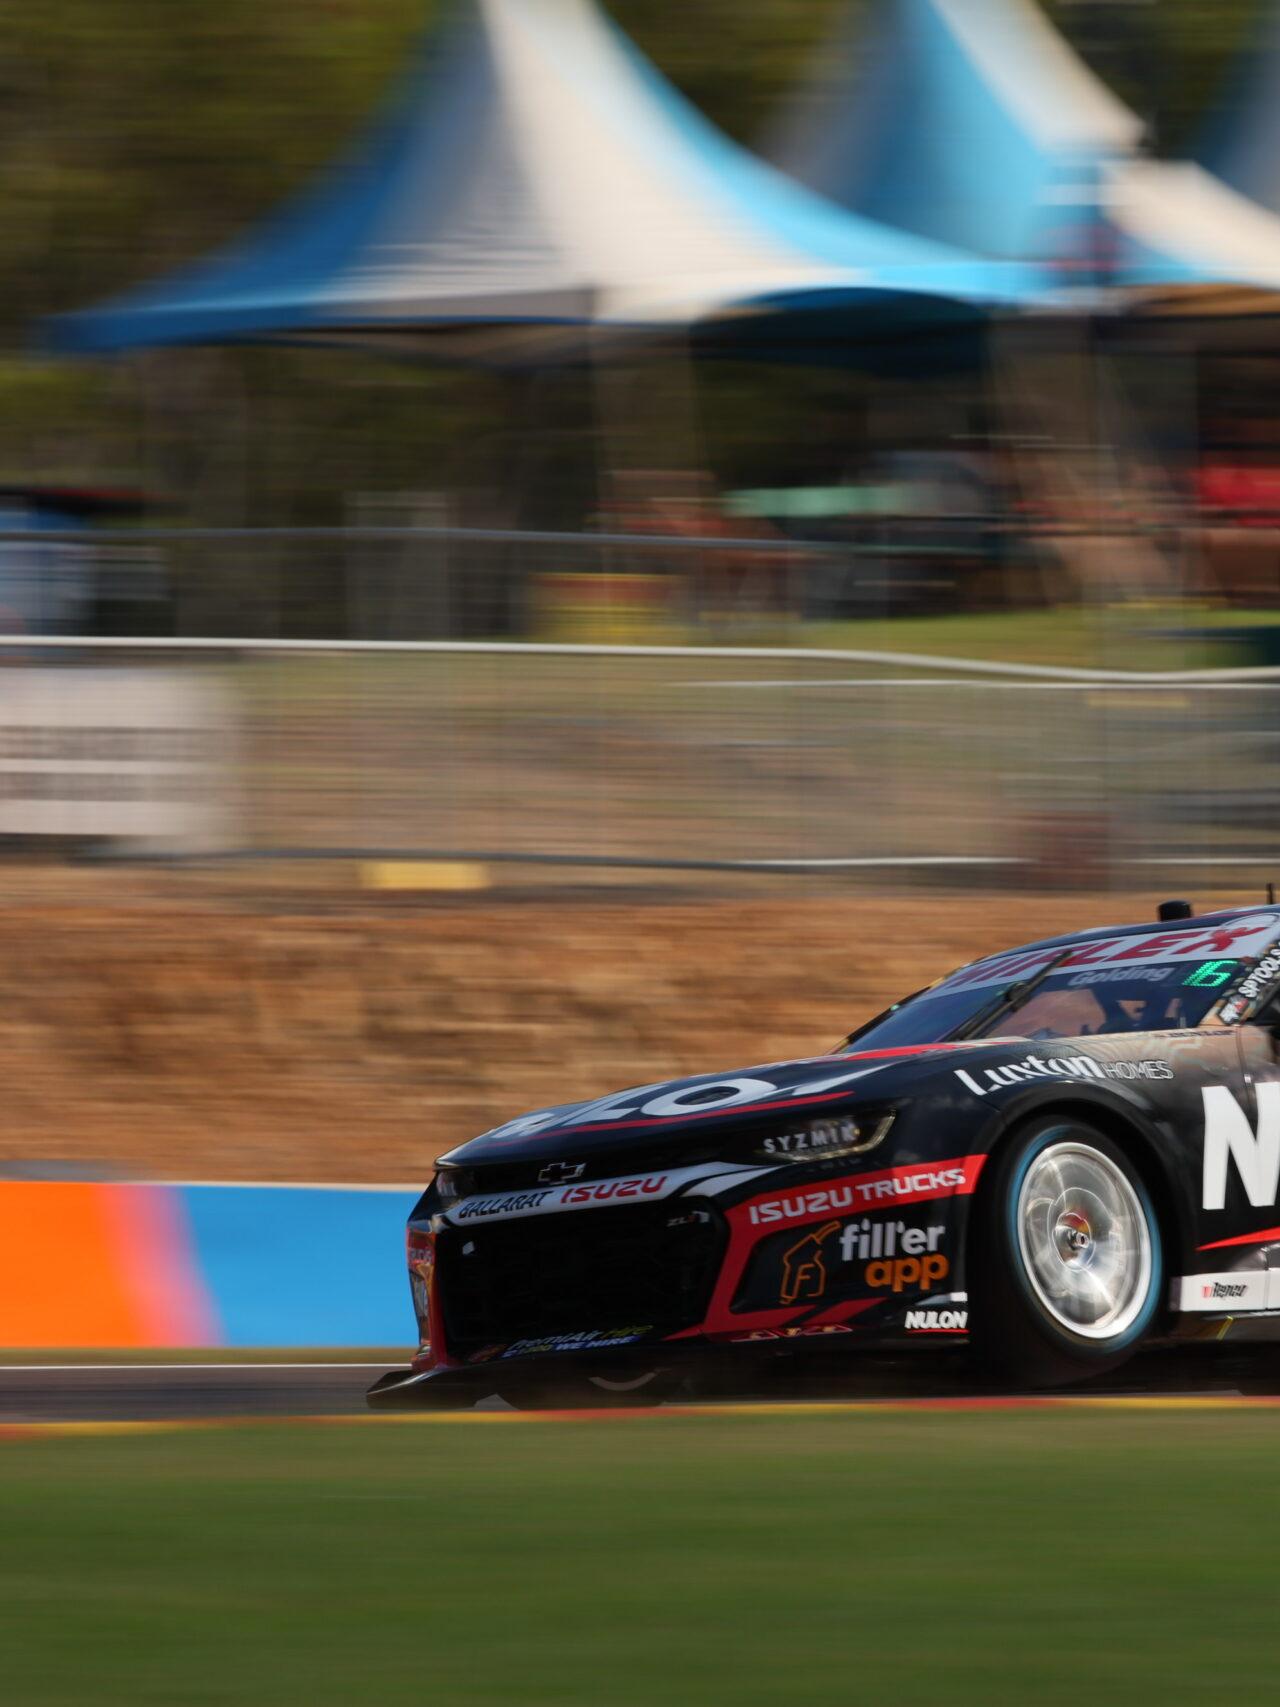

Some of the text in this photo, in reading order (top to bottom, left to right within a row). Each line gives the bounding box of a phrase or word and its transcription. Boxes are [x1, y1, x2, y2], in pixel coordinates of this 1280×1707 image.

[1067, 966, 1177, 986] Golding
[953, 1055, 1174, 1096] Luxton HOMES
[458, 1176, 668, 1219] BALLARAT ISUZU
[749, 1167, 966, 1224] ISUZU TRUCKS
[865, 1254, 949, 1292] app
[905, 1310, 969, 1330] NULON
